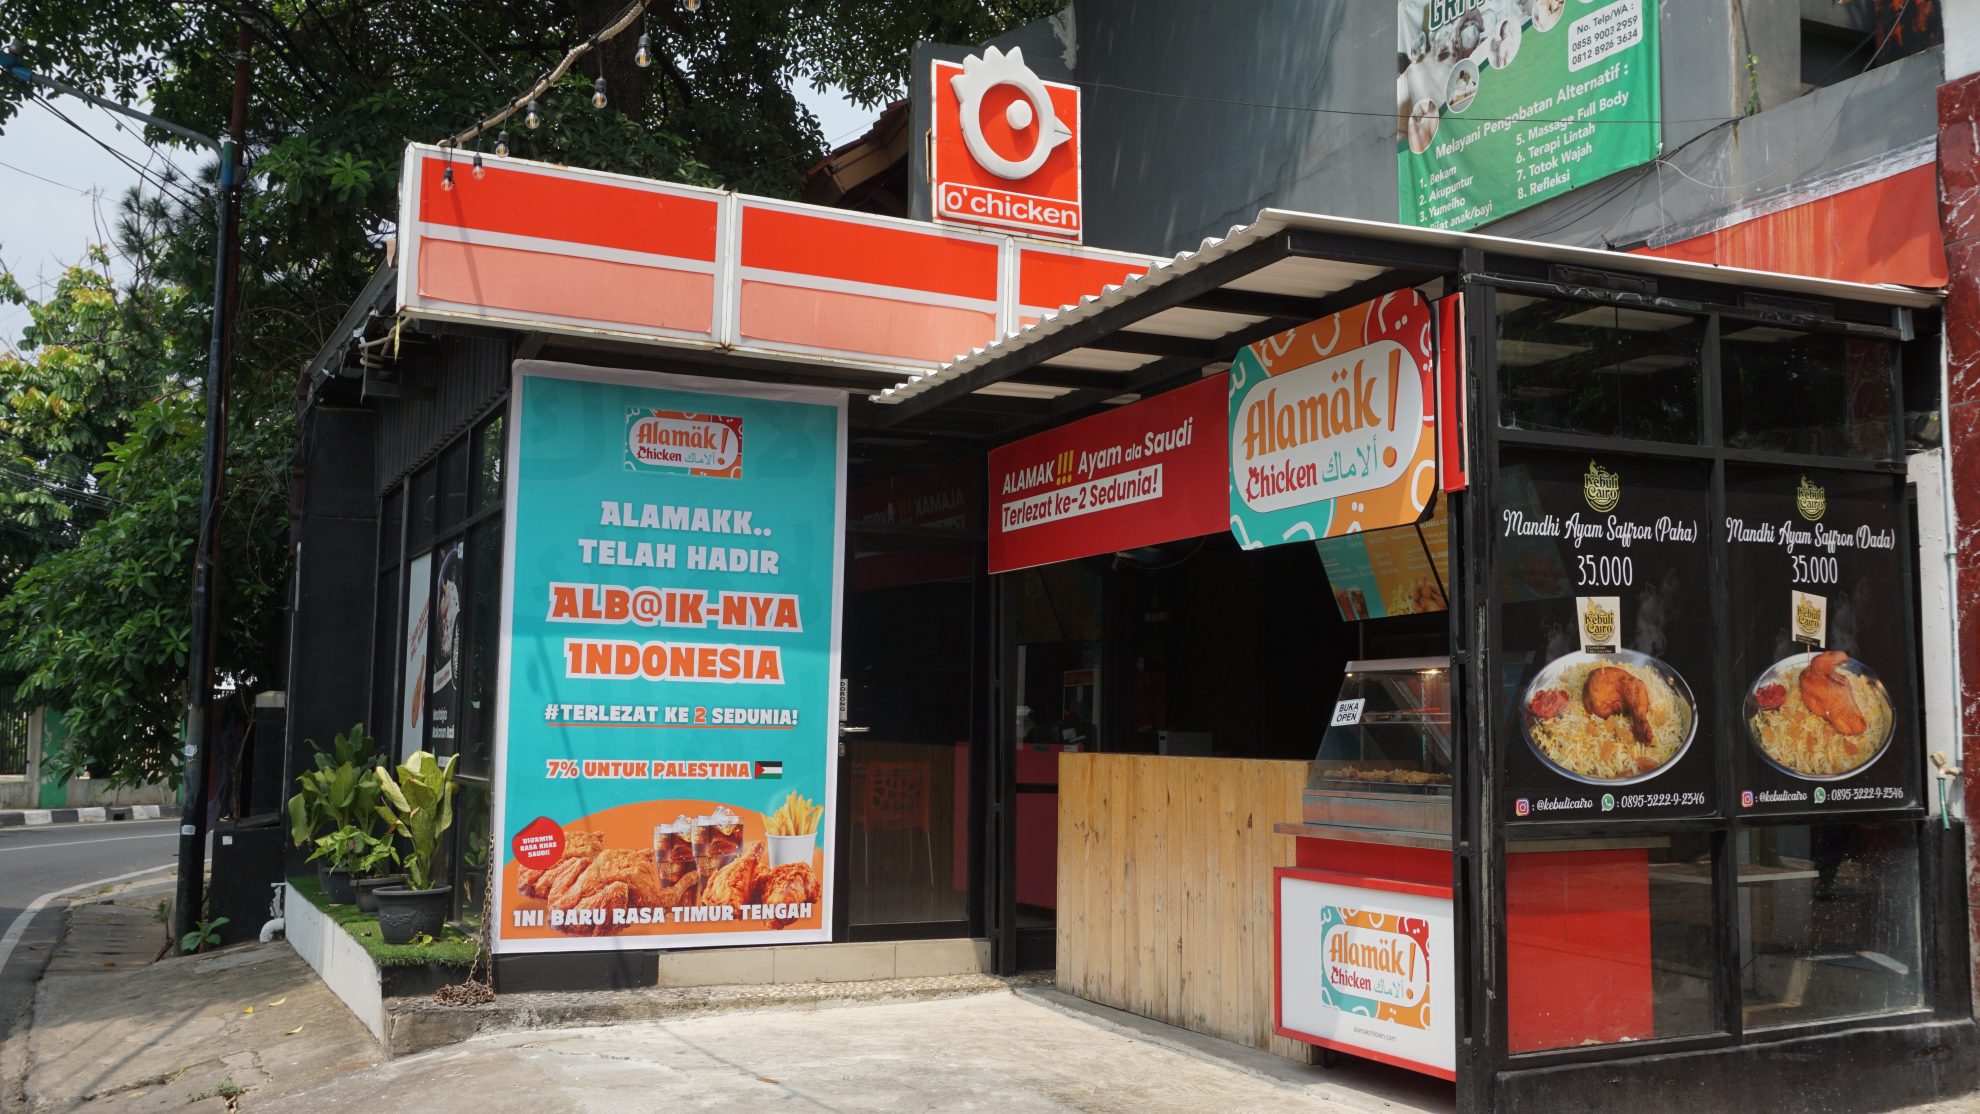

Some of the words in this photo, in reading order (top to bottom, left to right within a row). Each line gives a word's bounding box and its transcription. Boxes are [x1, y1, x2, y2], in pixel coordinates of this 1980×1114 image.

[1572, 36, 1592, 52] 0858
[1594, 26, 1615, 42] 9003
[1616, 15, 1638, 31] 2959
[1577, 24, 1591, 35] No.
[1593, 4, 1628, 27] Telp/WA
[1572, 50, 1592, 65] 0812
[1594, 39, 1614, 55] 8926
[1616, 28, 1638, 46] 3634
[1435, 129, 1481, 160] Melayani
[1483, 97, 1553, 139] Pengobatan
[1556, 62, 1621, 105] Alternatif
[1516, 133, 1525, 146] 5.
[1528, 115, 1574, 141] Massage
[1577, 101, 1596, 121] Full
[1599, 91, 1629, 112] Body
[1516, 151, 1526, 164] 6.
[1528, 135, 1561, 158] Terapi
[1563, 122, 1595, 145] Lintah
[1516, 169, 1526, 181] 7.
[1528, 155, 1558, 177] Totok
[1561, 141, 1592, 164] Wajah
[1419, 177, 1427, 188] 1.
[1430, 166, 1457, 185] Bekam
[1419, 194, 1427, 206] 2.
[1429, 175, 1473, 202] Akupuntur
[1517, 187, 1527, 200] 8.
[1529, 169, 1570, 195] Refleksi
[1419, 211, 1428, 222] 3.
[1429, 197, 1466, 217] Yumeiho
[1450, 200, 1493, 227] anak/bayi
[637, 446, 682, 463] Chicken
[1002, 459, 1054, 496] ALAMAK
[1077, 443, 1122, 477] Ayam
[1125, 443, 1142, 463] ala
[1144, 416, 1193, 456] Saudi
[1245, 459, 1318, 502] Chicken
[1584, 472, 1619, 489] Kebuli
[1586, 486, 1618, 500] Cairo
[1003, 496, 1052, 528] Terlezat
[1055, 487, 1087, 518] ke-2
[1089, 468, 1158, 509] Sedunia!
[600, 500, 772, 536] ALAMAKK..
[1503, 509, 1560, 538] Mandhi
[1564, 511, 1604, 549] Ayam
[1606, 514, 1652, 548] Saffron
[1654, 516, 1698, 544] (Paha)
[1726, 517, 1776, 545] Mandhi
[1778, 520, 1812, 554] Ayam
[1814, 522, 1855, 555] Saffron
[1855, 523, 1895, 551] (Dada)
[578, 538, 676, 568] TELAH
[687, 545, 779, 575] HADIR
[1577, 554, 1633, 587] 35.000
[1791, 554, 1838, 585] 35.000
[549, 583, 801, 631] ALB@IK-NYA
[1584, 610, 1614, 625] Kebuli
[1586, 624, 1613, 634] Cairo
[544, 703, 658, 723] #TERLEZAT
[664, 706, 689, 723] KE
[693, 707, 707, 723] 2
[711, 708, 798, 725] SEDUNIA!
[1336, 712, 1357, 723] OPEN
[1339, 702, 1359, 712] BUKA
[546, 759, 579, 779] 7%
[583, 760, 648, 779] UNTUK
[652, 760, 752, 779] PALESTINA
[1536, 796, 1593, 811] @kebulicairo
[1759, 789, 1807, 802] @kebulicairo
[522, 835, 553, 844] DIJAMIN
[551, 908, 606, 926] BARU
[612, 906, 666, 924] RASA
[671, 904, 734, 923] TIMUR
[740, 903, 812, 921] TENGAH
[1331, 966, 1372, 992] Chicken
